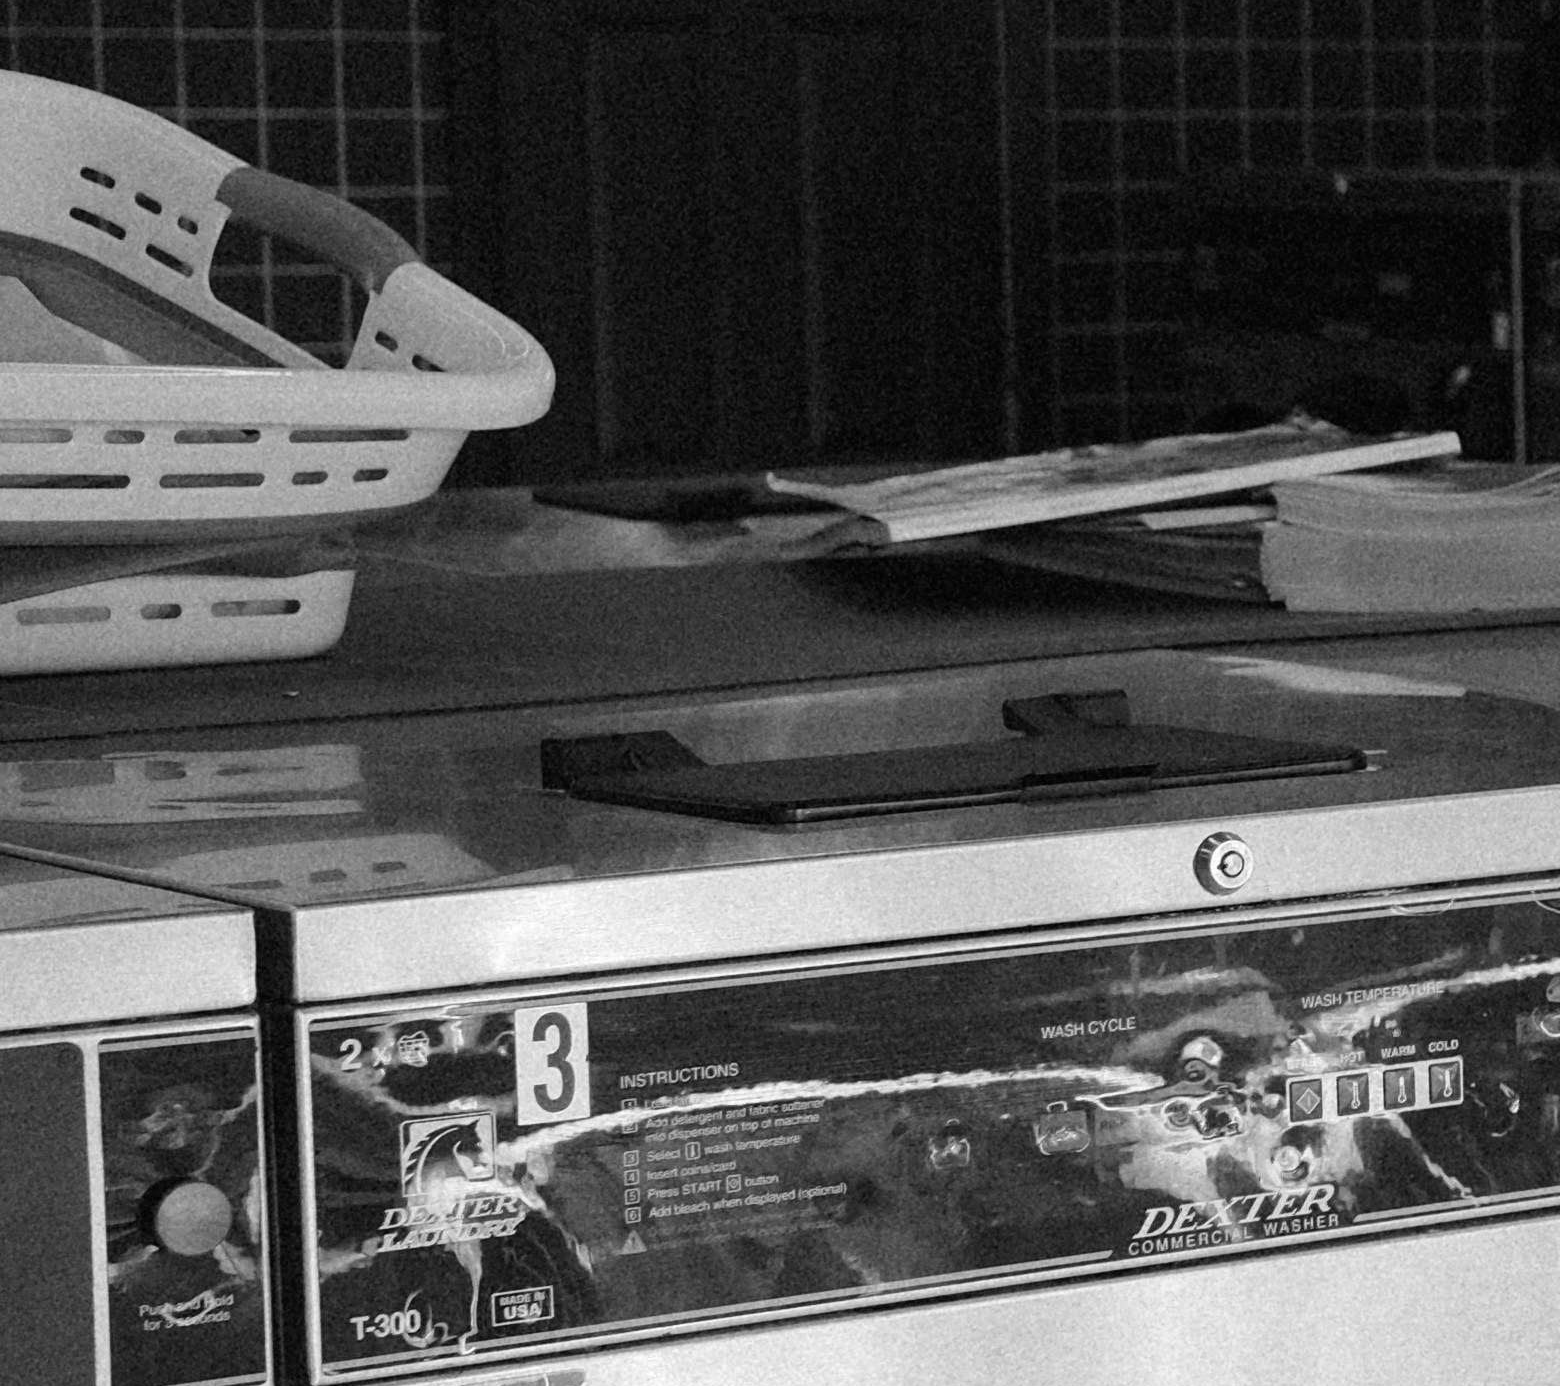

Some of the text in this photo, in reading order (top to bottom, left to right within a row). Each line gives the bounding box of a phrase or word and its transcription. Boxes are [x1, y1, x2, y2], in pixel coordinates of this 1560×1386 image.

[1301, 980, 1445, 1010] WASH TEMPERATURE
[1040, 1016, 1137, 1040] WASH CYCLE
[340, 1038, 362, 1071] 2
[1380, 1043, 1416, 1059] WARM
[1427, 1038, 1459, 1053] COLD
[532, 1011, 576, 1114] 3
[619, 1063, 739, 1090] INSTRUCTIONS
[671, 1111, 722, 1126] detergent
[725, 1107, 746, 1119] and
[749, 1104, 779, 1116] fabric
[781, 1098, 826, 1113] softener
[668, 1125, 722, 1140] dispenser
[724, 1123, 739, 1133] on
[741, 1121, 759, 1134] top
[774, 1114, 820, 1127] machine
[646, 1134, 801, 1161] Select wash temperature
[647, 1168, 678, 1180] Insert
[647, 1175, 779, 1199] Press START button
[650, 1182, 847, 1218] Add bleach when displayed (optional)
[1132, 1183, 1336, 1239] DEXTER
[377, 1212, 526, 1253] LAUNDRY
[1128, 1213, 1340, 1256] COMMERCIAL WASHER
[499, 1293, 527, 1307] MADE
[503, 1300, 542, 1319] USA
[349, 1308, 421, 1341] T-300
